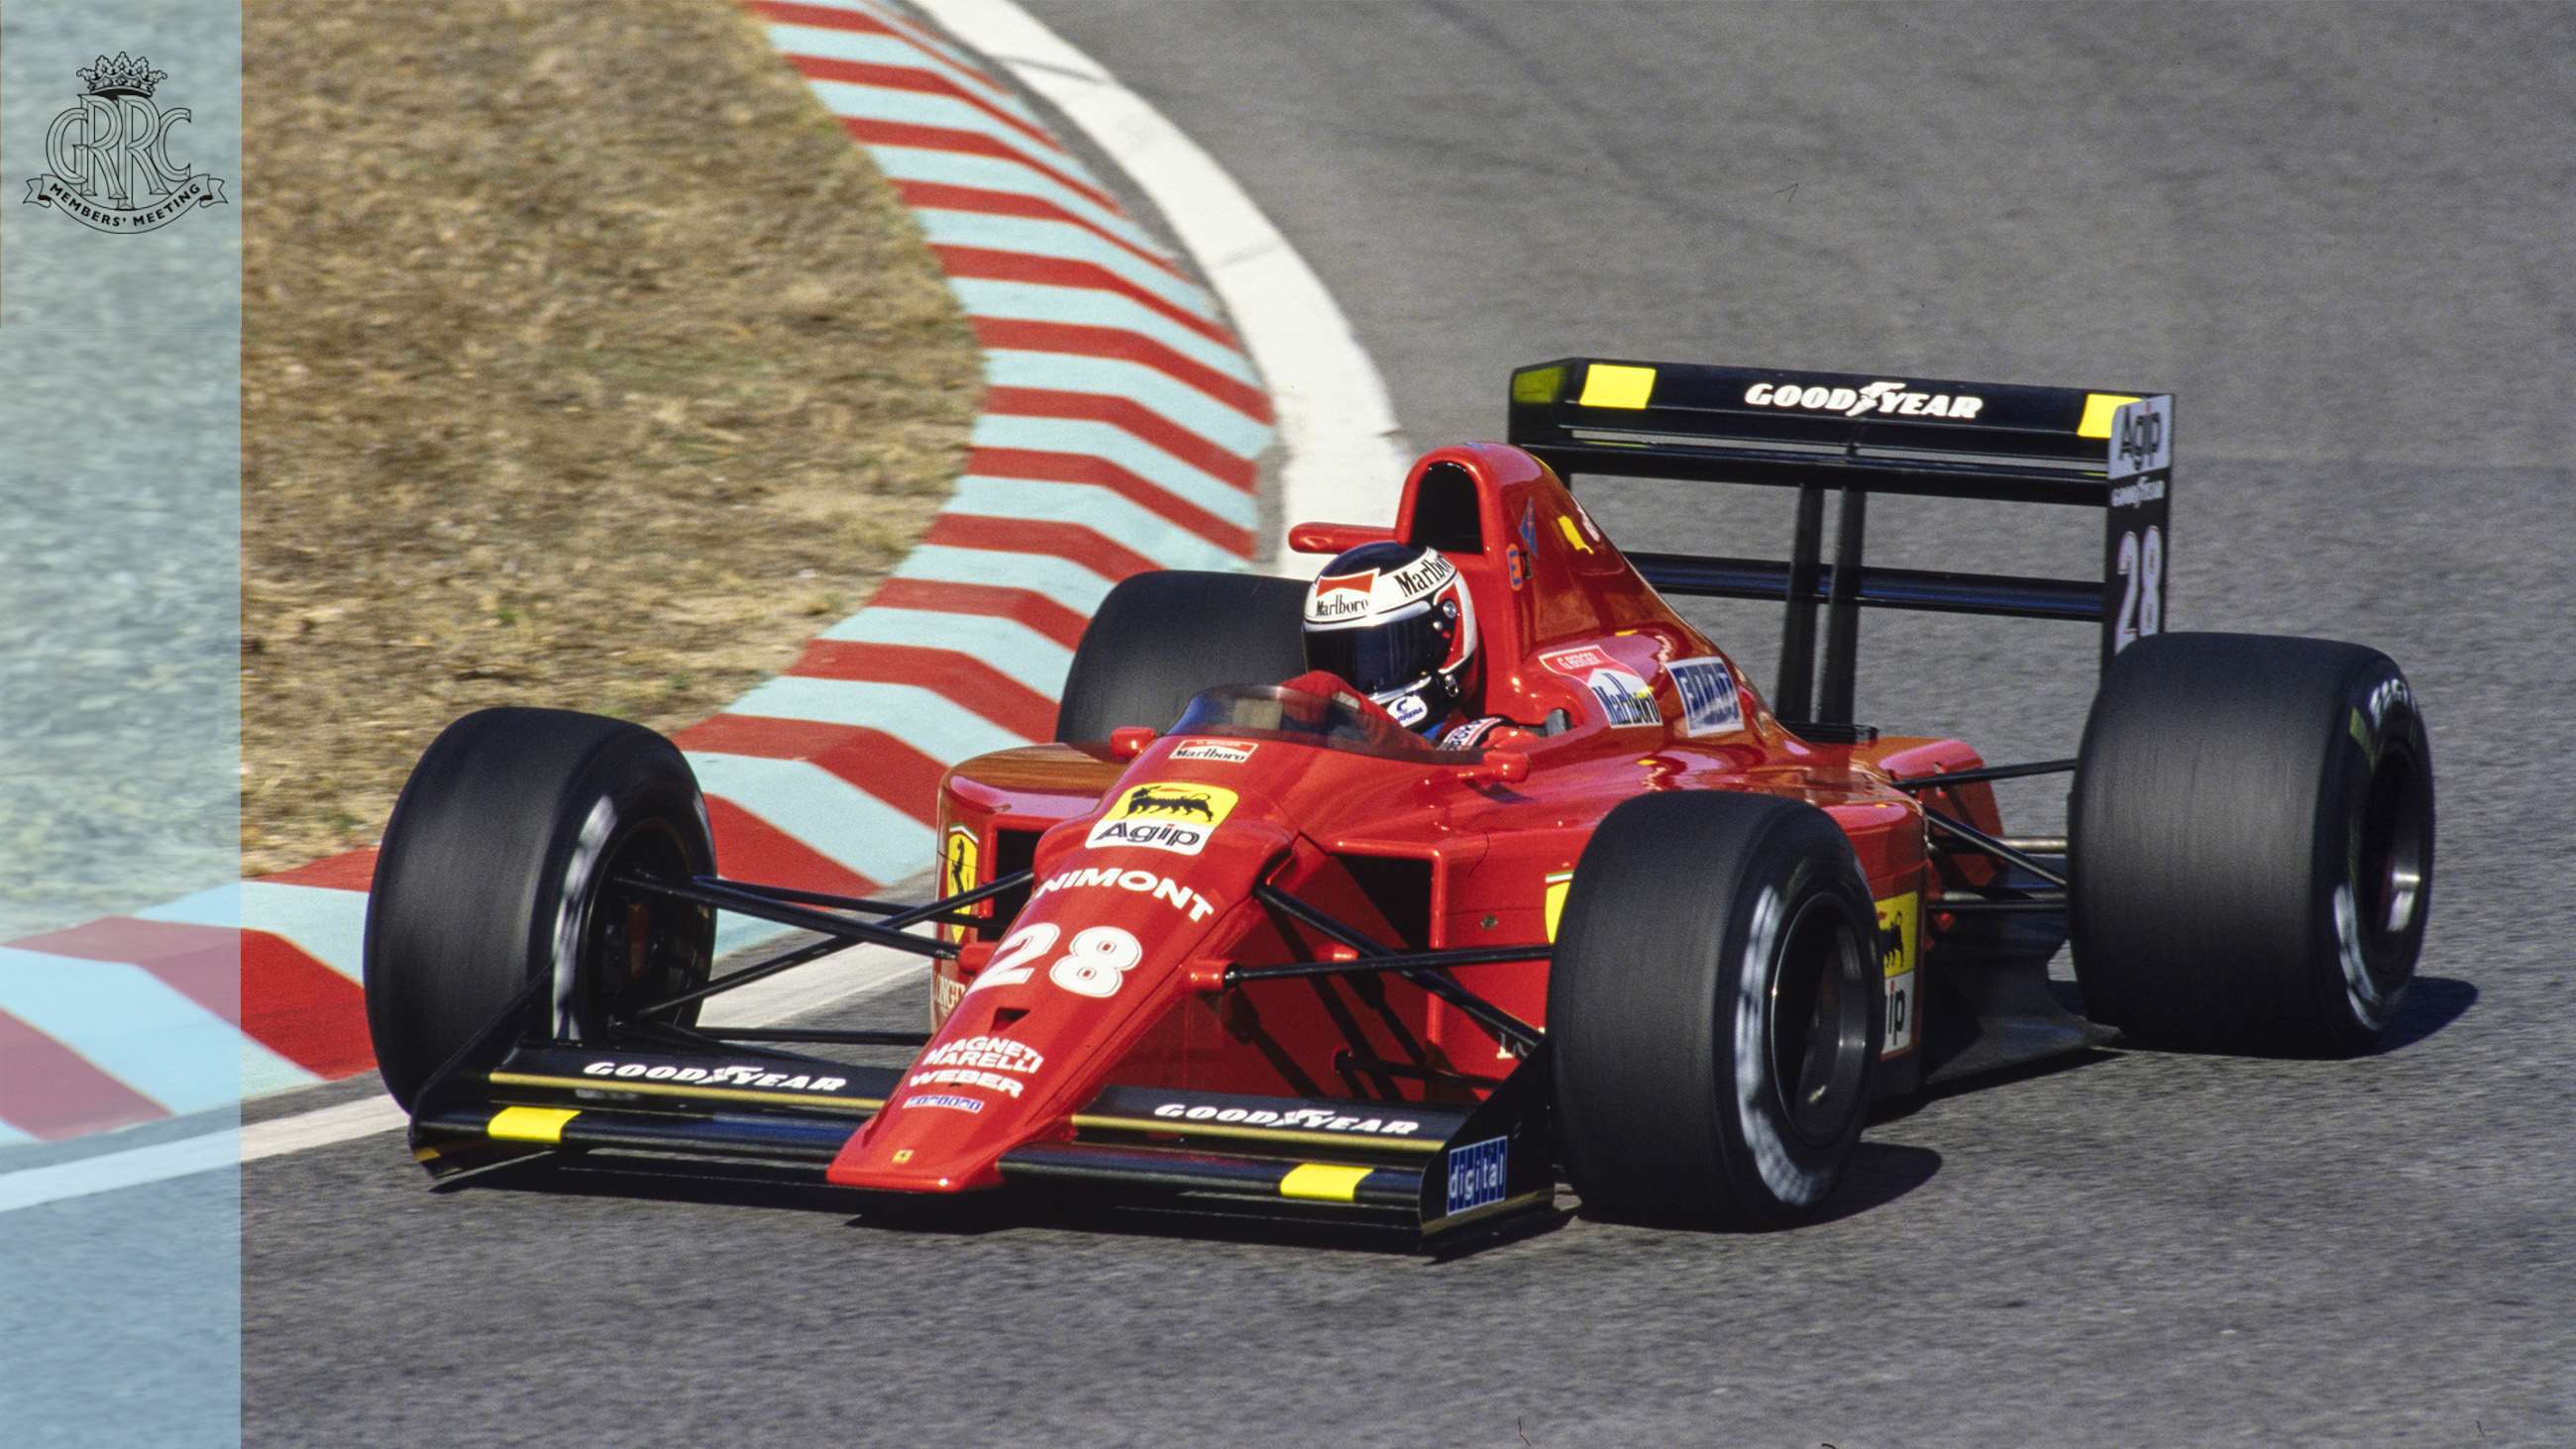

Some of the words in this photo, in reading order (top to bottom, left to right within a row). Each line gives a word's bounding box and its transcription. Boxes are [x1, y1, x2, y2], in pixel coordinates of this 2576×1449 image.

[1745, 382, 1983, 418] GOODYEAR
[1316, 594, 1368, 616] Marlboro
[2113, 526, 2162, 655] 28
[1094, 822, 1200, 846] Agip
[1031, 868, 1215, 922] NIMONT
[969, 922, 1142, 998] 28
[1884, 981, 1905, 1046] ip
[925, 1036, 1043, 1068] MAGNETI
[584, 1062, 845, 1090] GOODYEAR
[910, 1070, 1023, 1098] WEBER
[1154, 1103, 1419, 1134] GOODYEAR
[1449, 1154, 1504, 1200] digital
